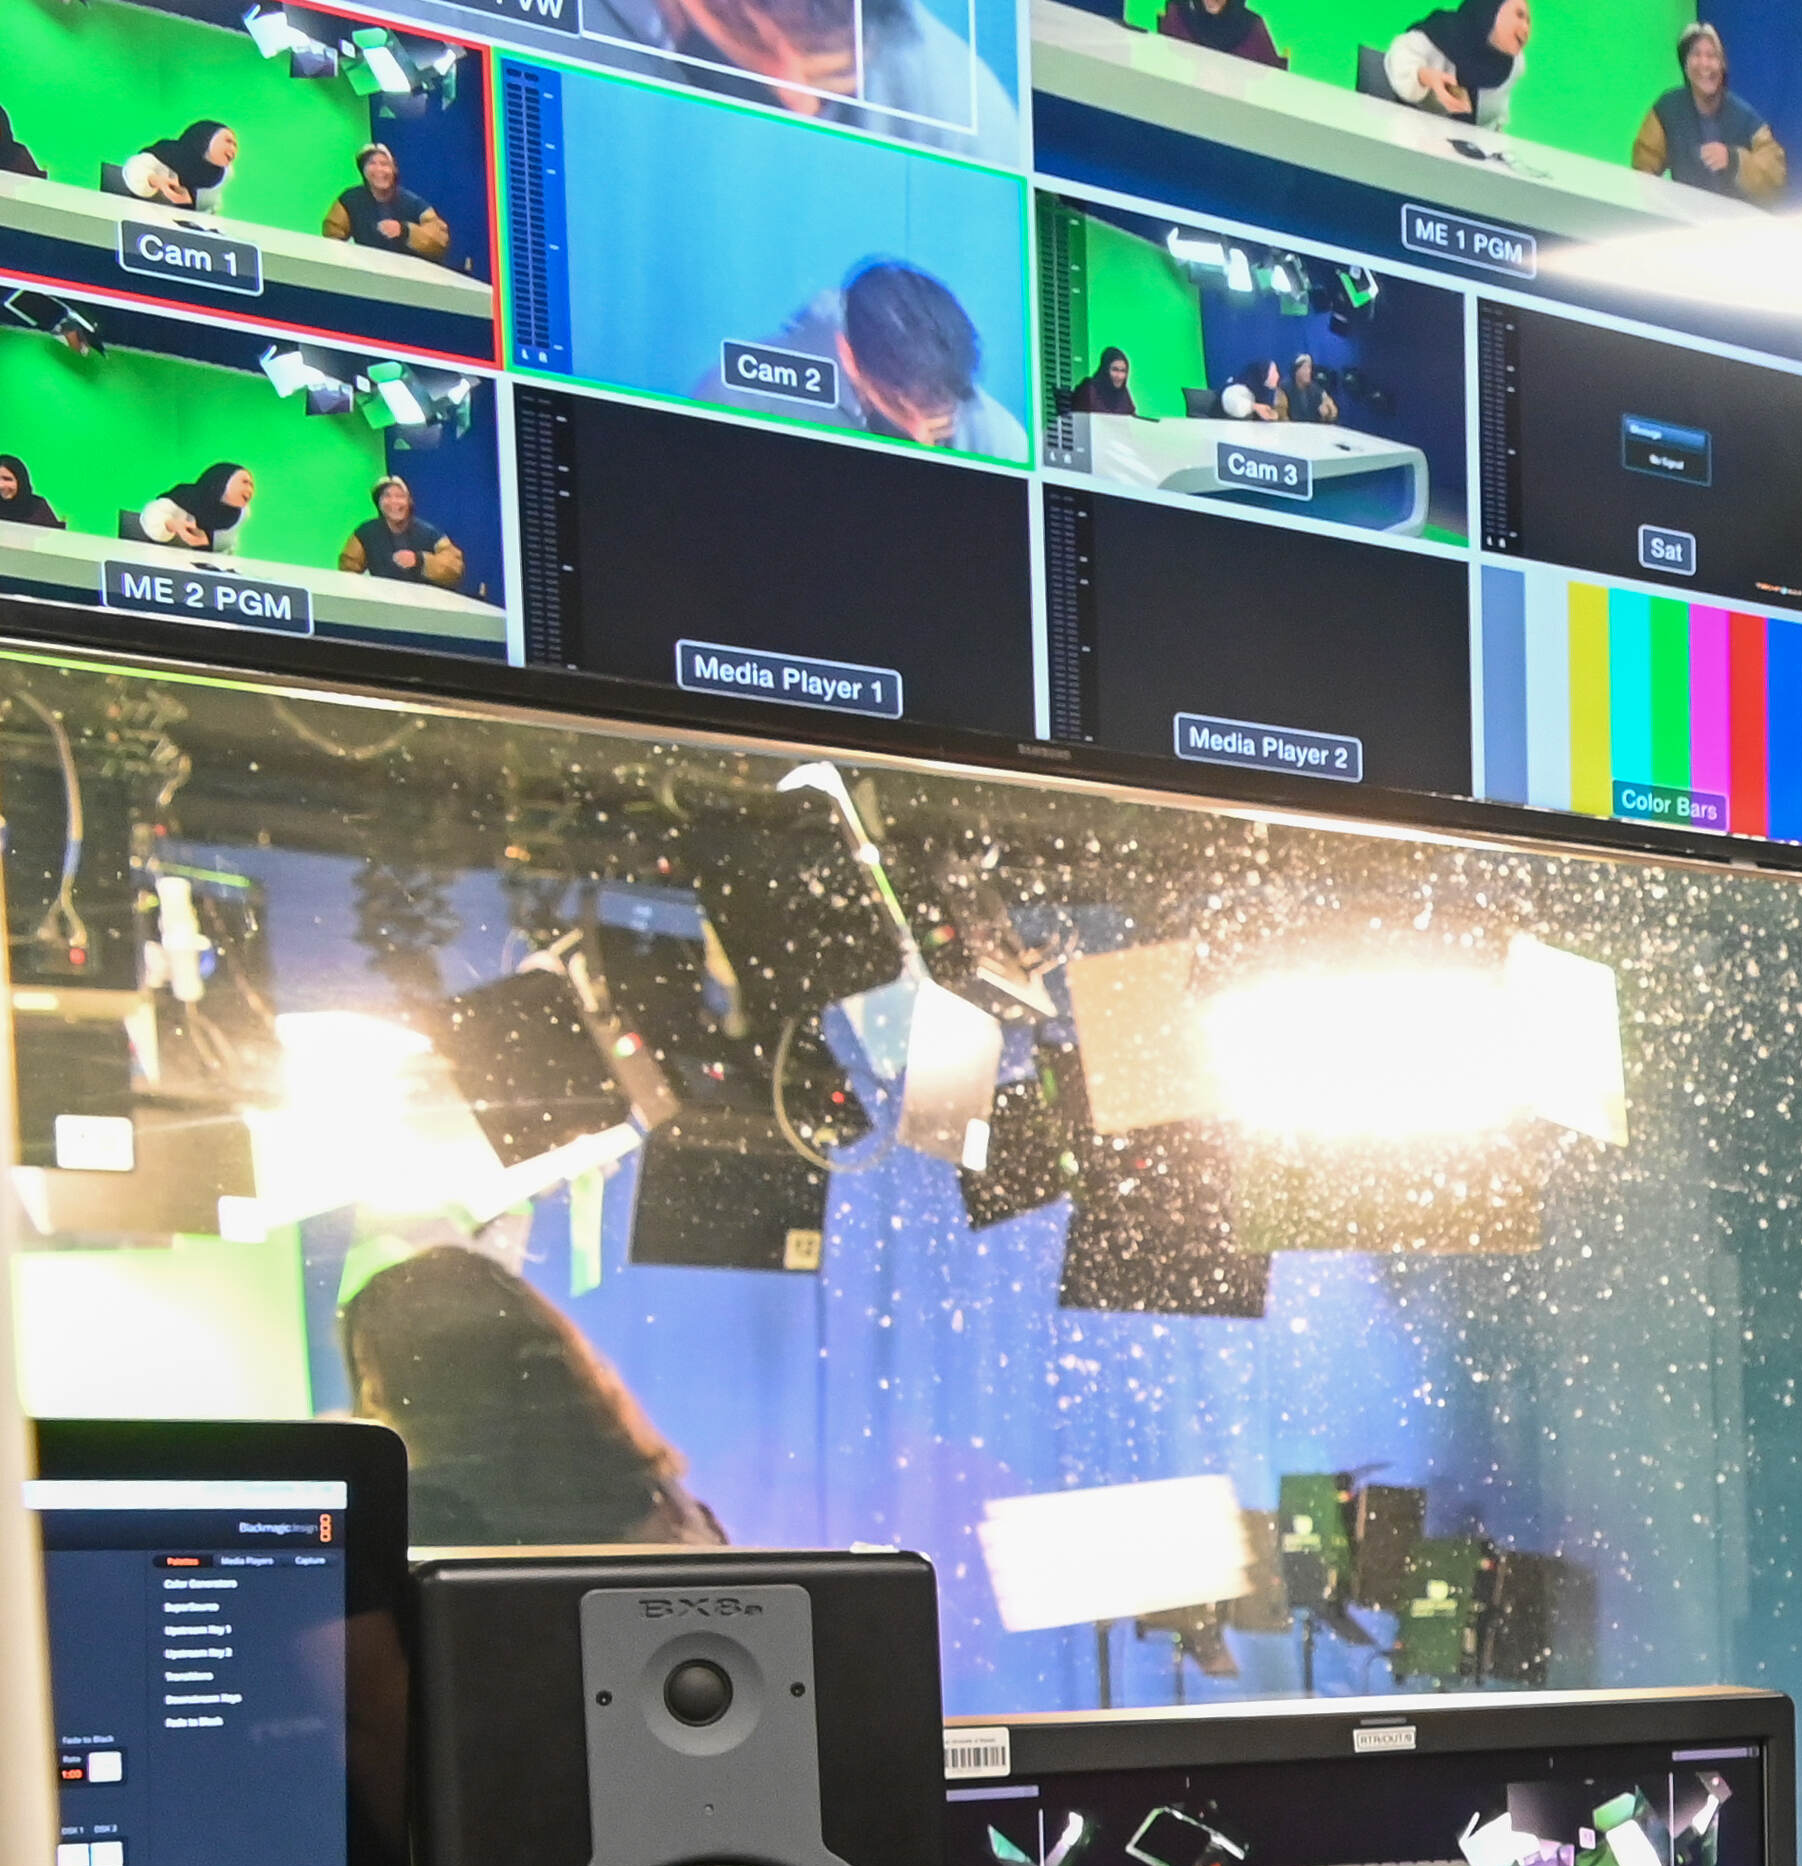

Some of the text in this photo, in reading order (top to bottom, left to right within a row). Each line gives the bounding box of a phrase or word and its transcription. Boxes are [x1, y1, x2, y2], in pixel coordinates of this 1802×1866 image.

[138, 233, 238, 277] Cam 1
[1416, 219, 1523, 264] ME 1 PGM
[738, 354, 821, 392] Cam 2
[1228, 453, 1297, 485] Cam 3
[1651, 537, 1683, 563] Sat
[123, 574, 291, 621] ME 2 PGM
[694, 656, 882, 703] Media Player 1
[1190, 727, 1348, 769] Media Player 2
[1621, 789, 1718, 821] Color Bars
